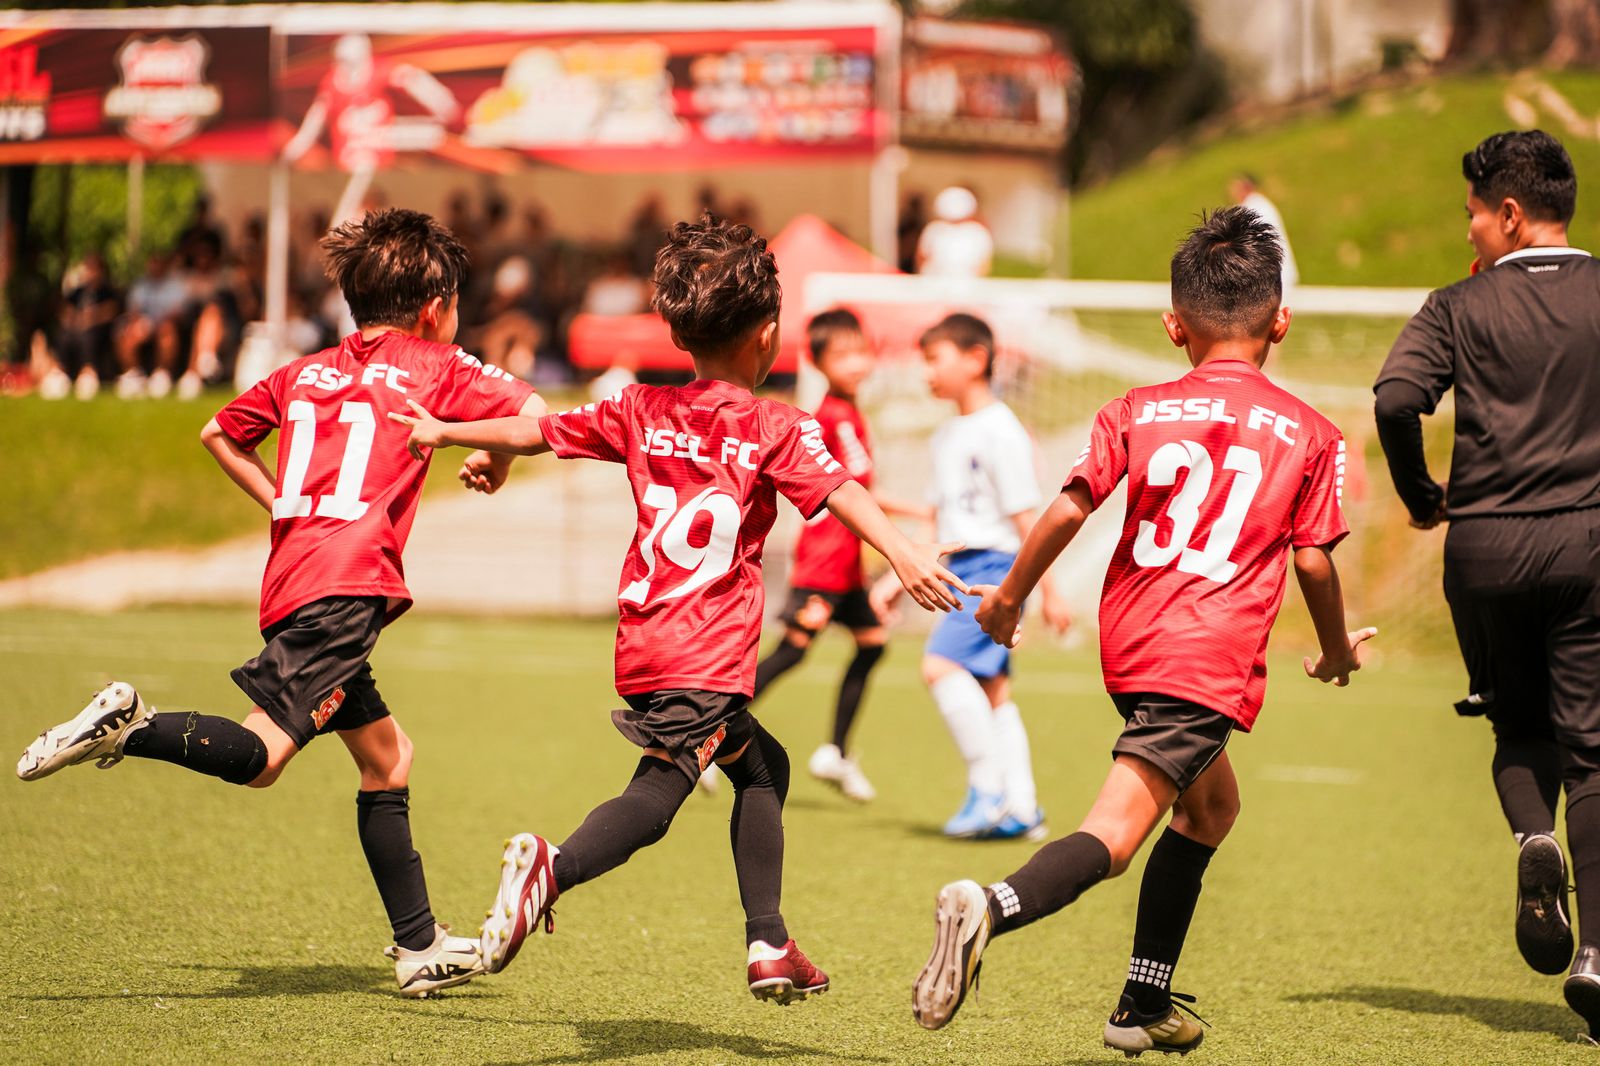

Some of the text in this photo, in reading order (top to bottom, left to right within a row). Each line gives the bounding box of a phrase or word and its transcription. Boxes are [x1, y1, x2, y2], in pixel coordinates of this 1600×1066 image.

[361, 363, 410, 394] FC
[272, 400, 376, 521] 11
[640, 427, 759, 470] JSSL FC
[1136, 398, 1299, 446] JSSL FC
[618, 484, 741, 605] 19
[1133, 440, 1263, 584] 31
